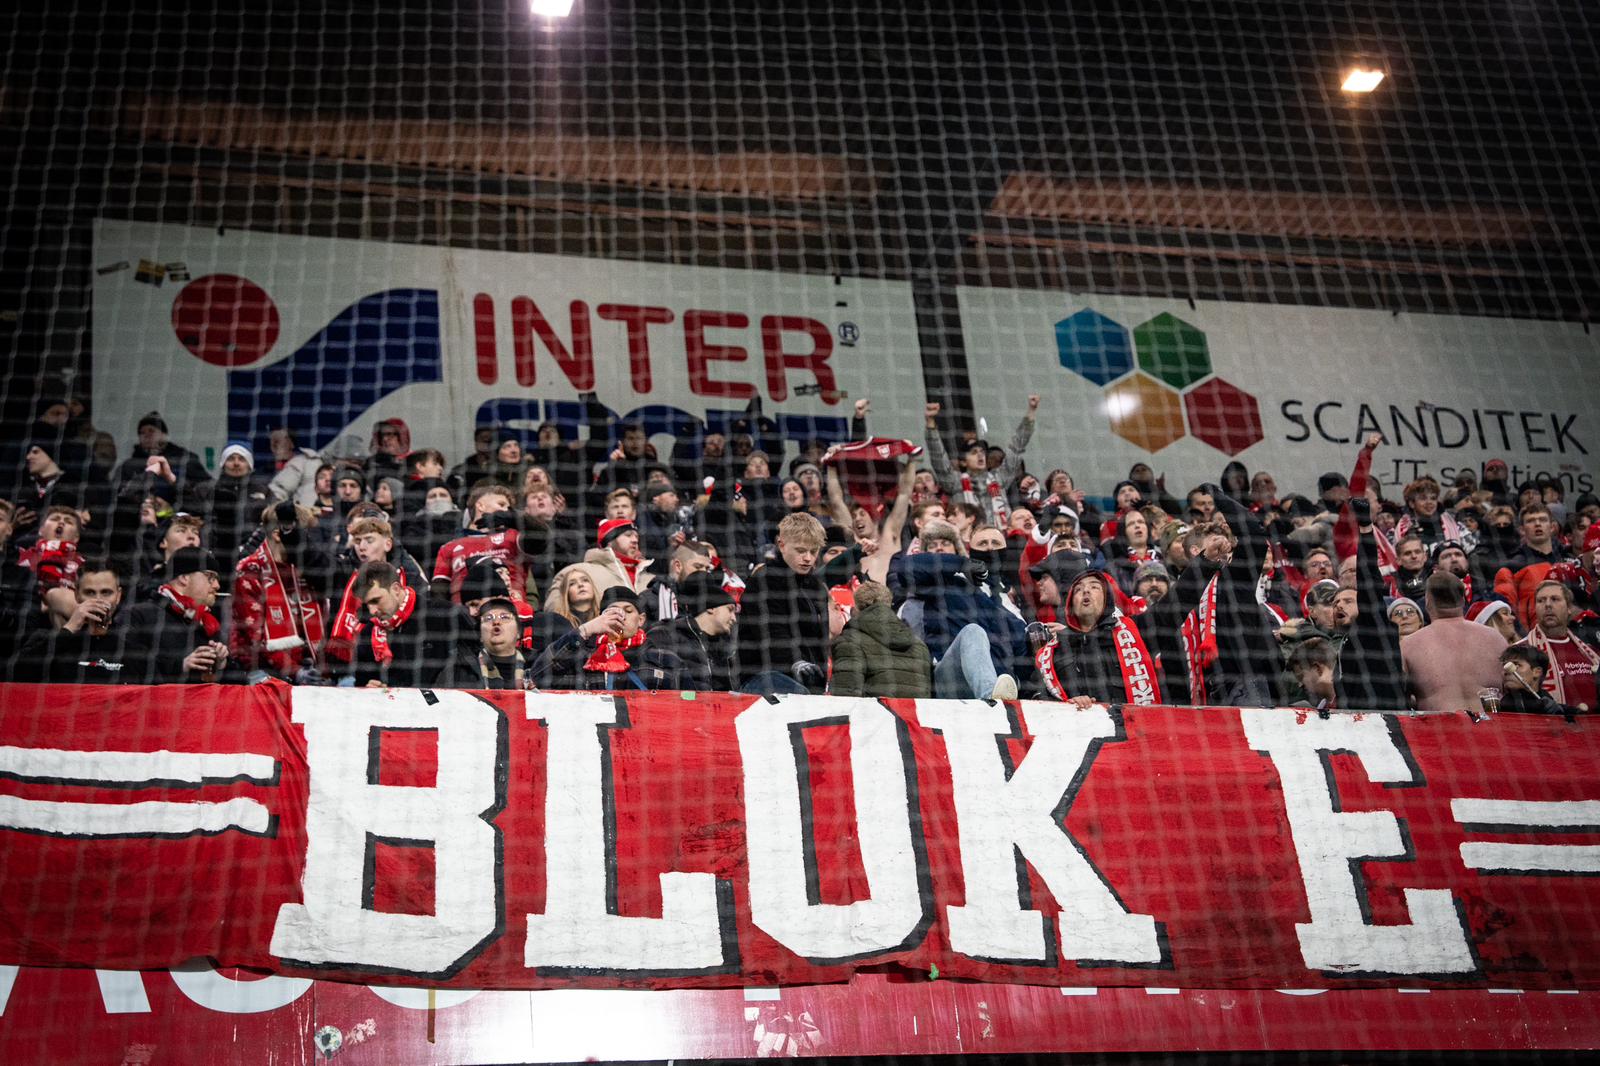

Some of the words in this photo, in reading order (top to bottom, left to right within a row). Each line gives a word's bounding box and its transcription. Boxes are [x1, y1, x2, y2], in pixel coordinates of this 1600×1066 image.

[473, 292, 840, 406] INTER
[1281, 399, 1590, 456] SCANDITEK
[1391, 458, 1427, 486] IT
[269, 685, 1173, 980] BLOK
[1240, 707, 1483, 979] E
